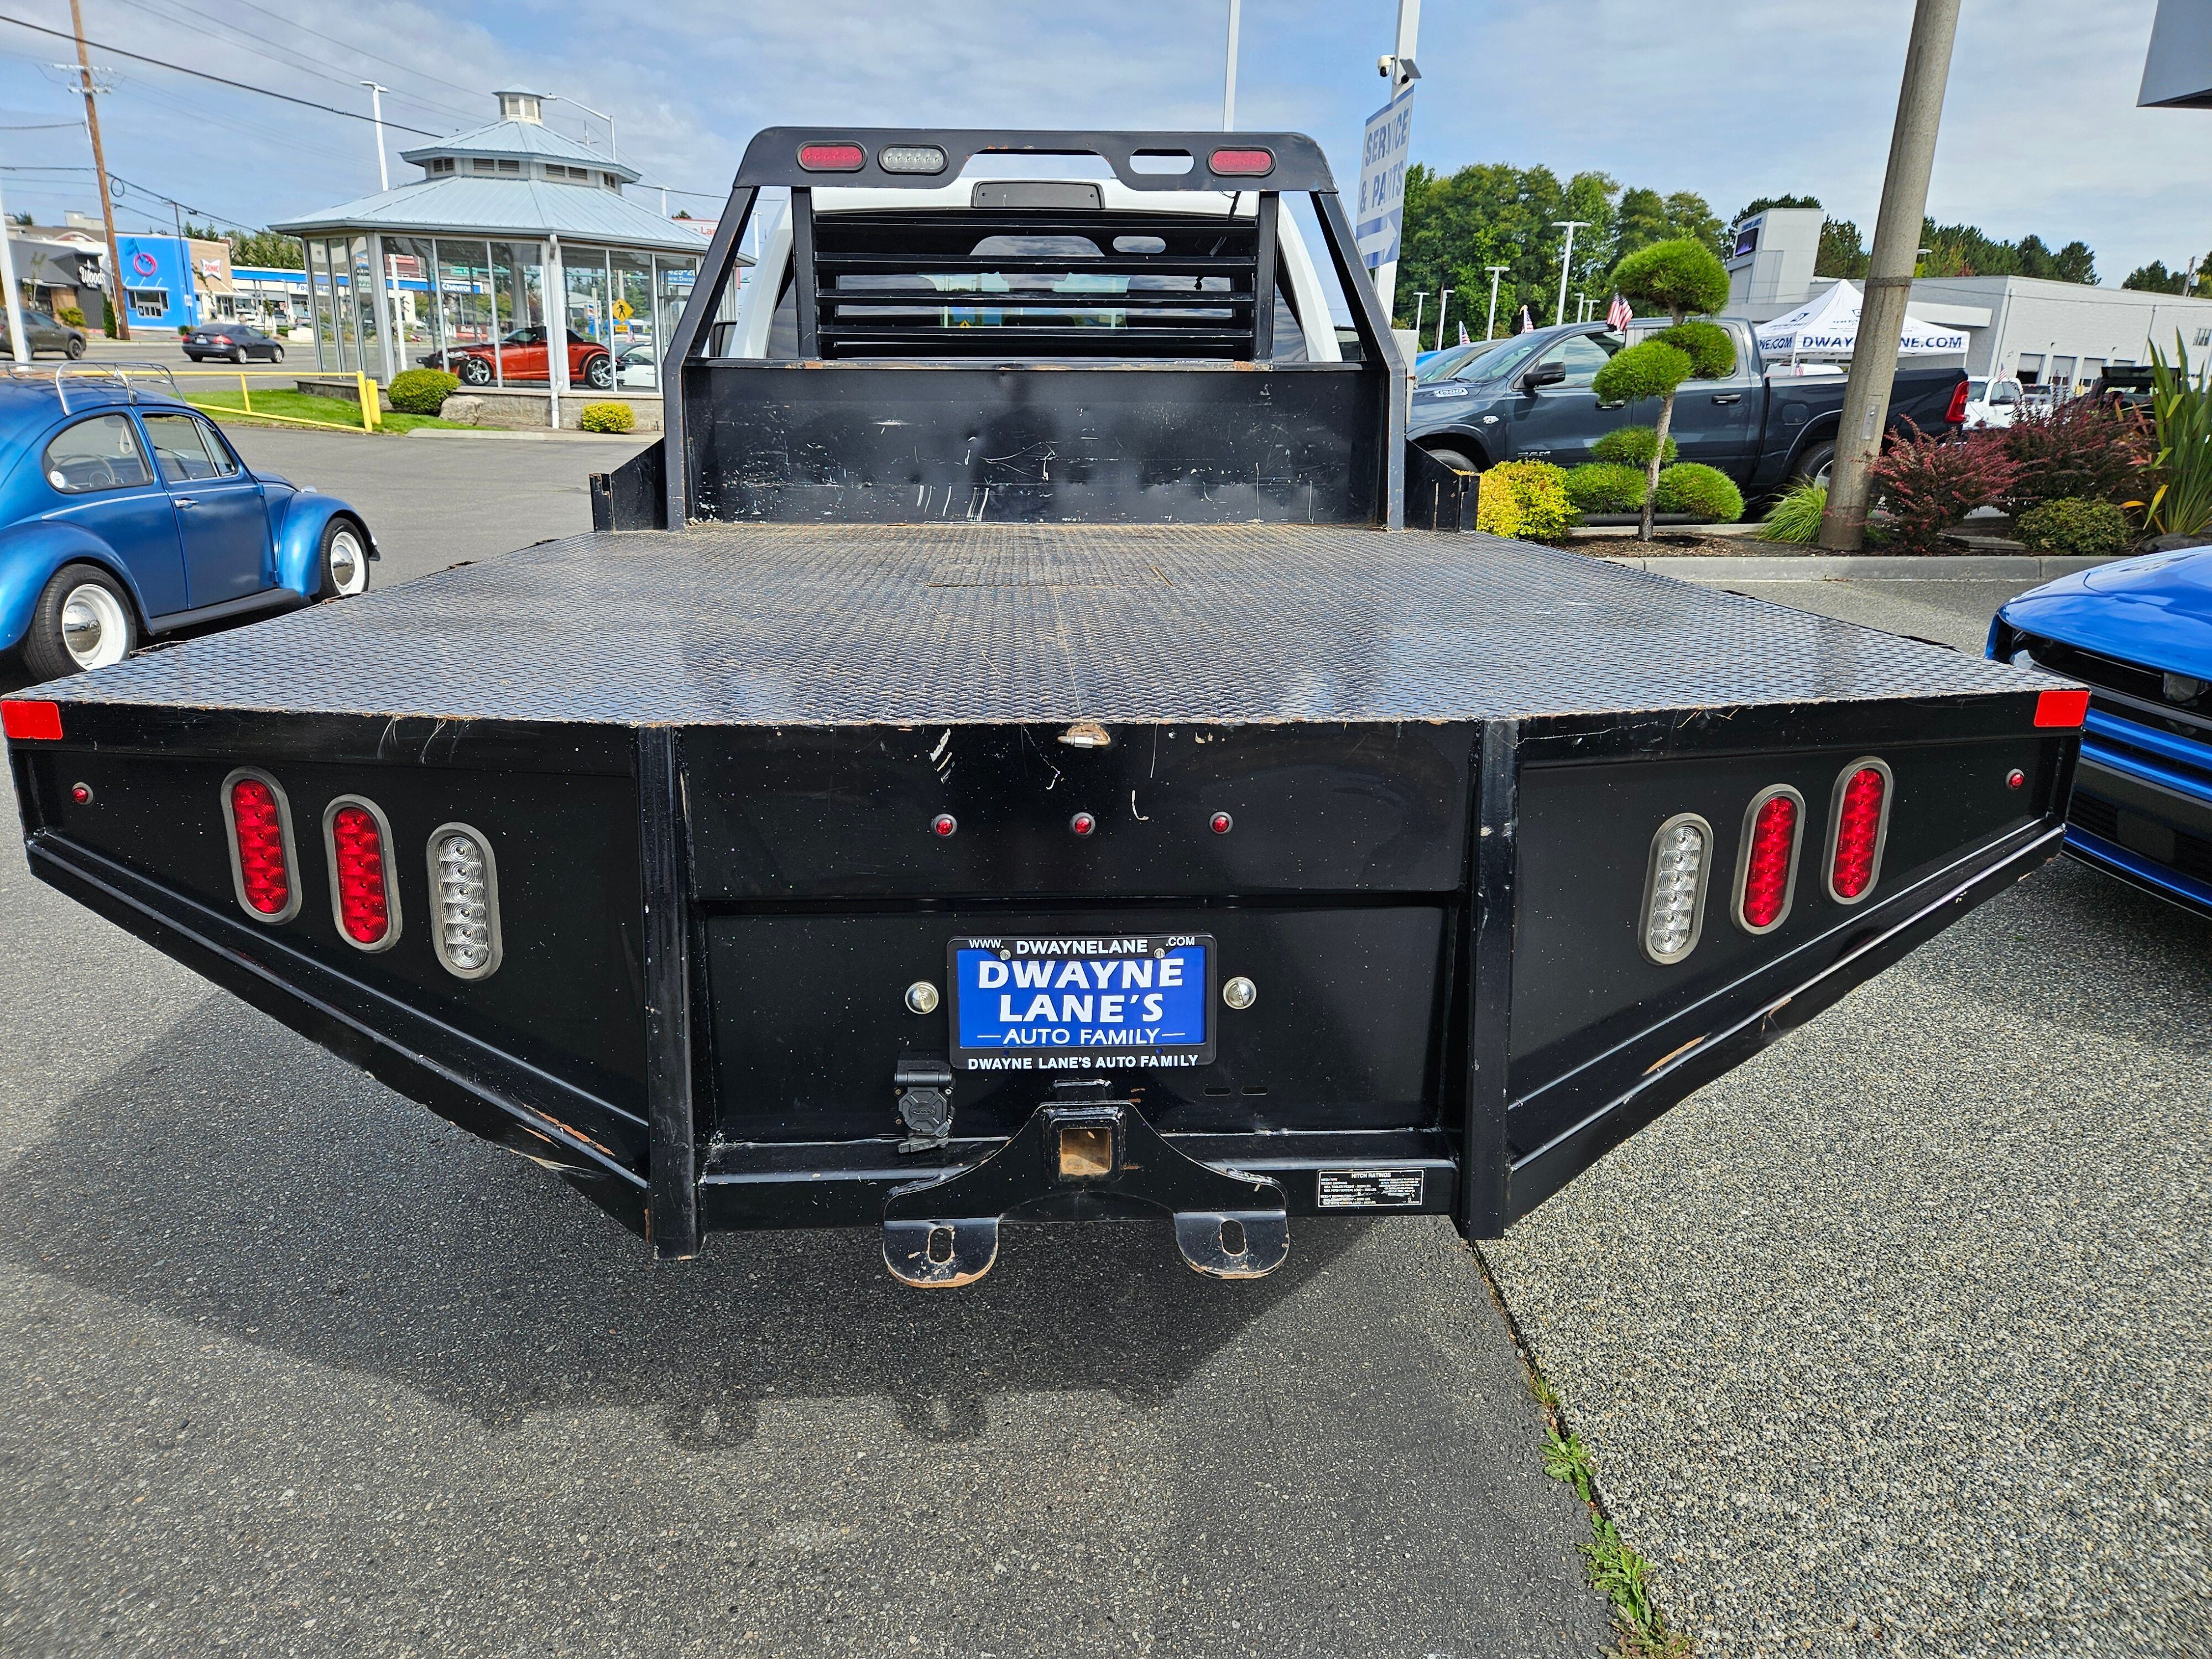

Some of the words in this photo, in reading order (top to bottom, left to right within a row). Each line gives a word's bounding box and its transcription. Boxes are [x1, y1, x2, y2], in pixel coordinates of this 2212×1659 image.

[1365, 107, 1409, 166] SERVICE
[1360, 180, 1368, 214] &
[1371, 159, 1404, 208] PARTS
[79, 265, 106, 284] Woods
[205, 264, 219, 273] SONIC
[442, 283, 471, 293] Chevron
[969, 939, 1004, 949] WWW.
[1016, 939, 1149, 955] DWAYNELANE
[1165, 937, 1196, 947] .COM
[978, 958, 1185, 989] DWAYNE
[999, 993, 1164, 1023] LANE'S
[1003, 1029, 1070, 1045] AUTO
[1080, 1027, 1160, 1045] FAMILY
[968, 1057, 1032, 1070] DWAYNE
[1039, 1057, 1091, 1070] LANE'S
[1095, 1056, 1136, 1068] AUTO
[1140, 1054, 1198, 1068] FAMILY
